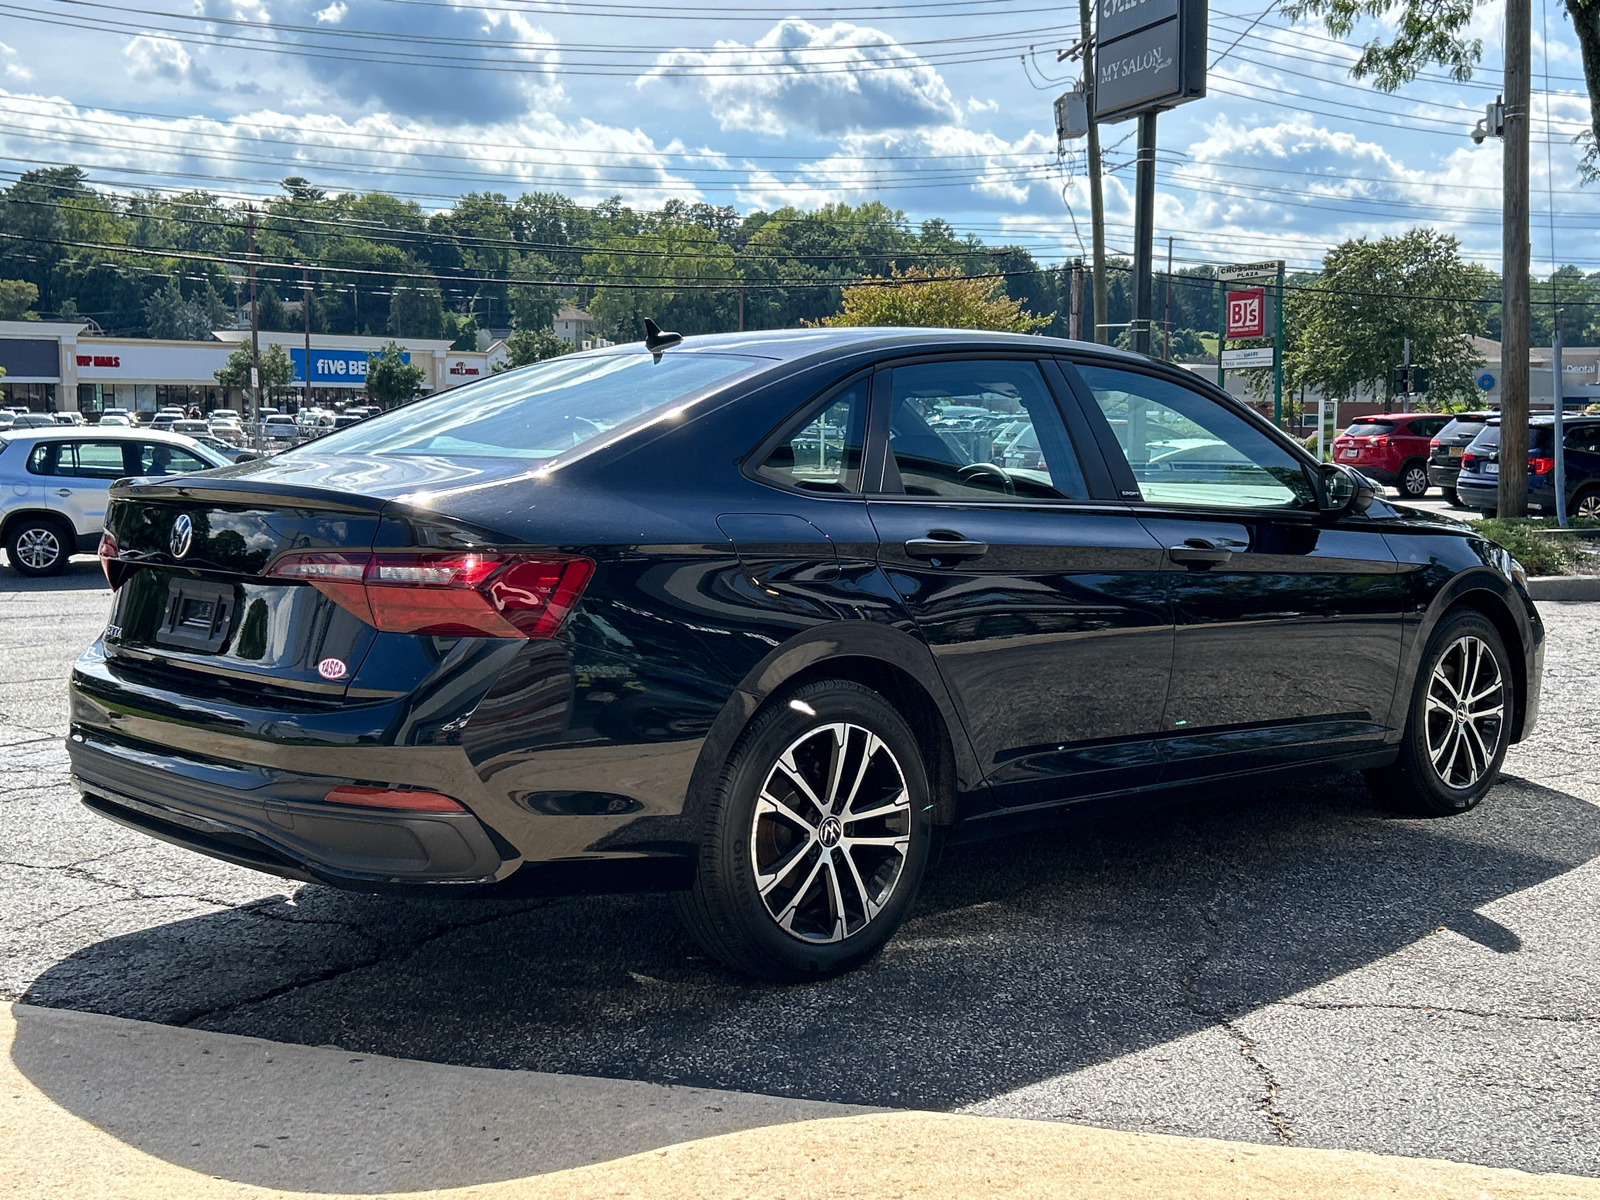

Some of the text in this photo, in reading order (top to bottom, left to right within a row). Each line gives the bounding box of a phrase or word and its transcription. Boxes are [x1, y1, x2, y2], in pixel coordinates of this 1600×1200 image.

[1101, 47, 1162, 84] MY SALON
[1221, 262, 1275, 274] CROSSROADS
[316, 359, 347, 375] five
[1566, 364, 1596, 374] Dental
[321, 660, 343, 677] TASCA
